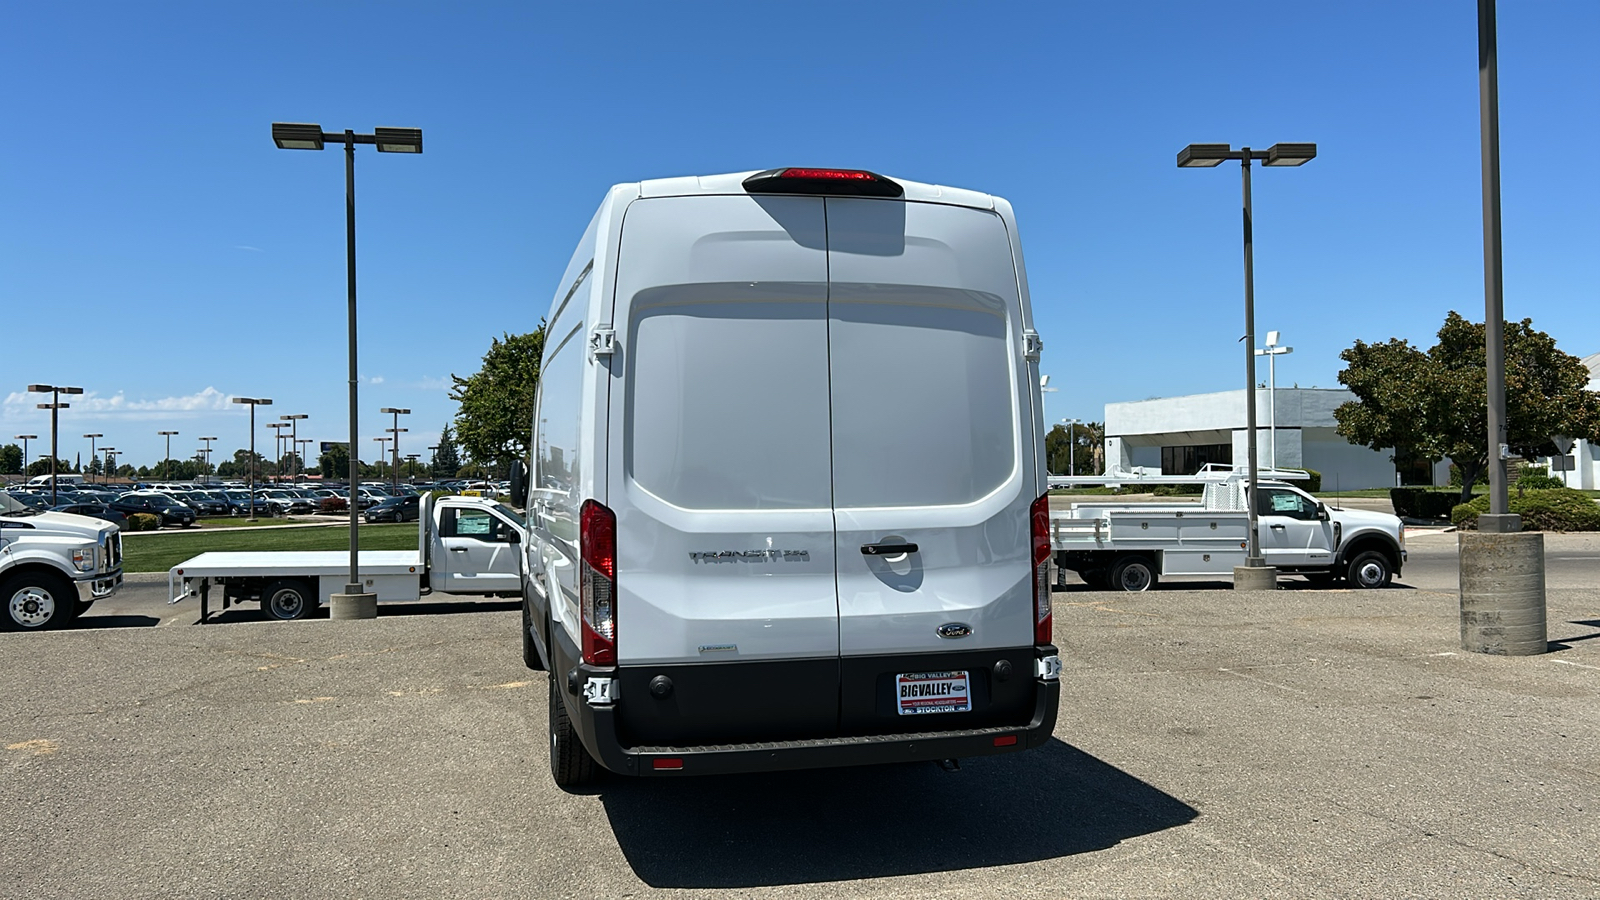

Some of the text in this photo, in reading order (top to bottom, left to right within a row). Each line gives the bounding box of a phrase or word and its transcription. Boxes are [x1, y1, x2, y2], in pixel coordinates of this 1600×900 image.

[689, 550, 781, 560] TRANSIT
[901, 682, 952, 697] BIGVALLEY
[916, 705, 955, 713] STOCKTON
